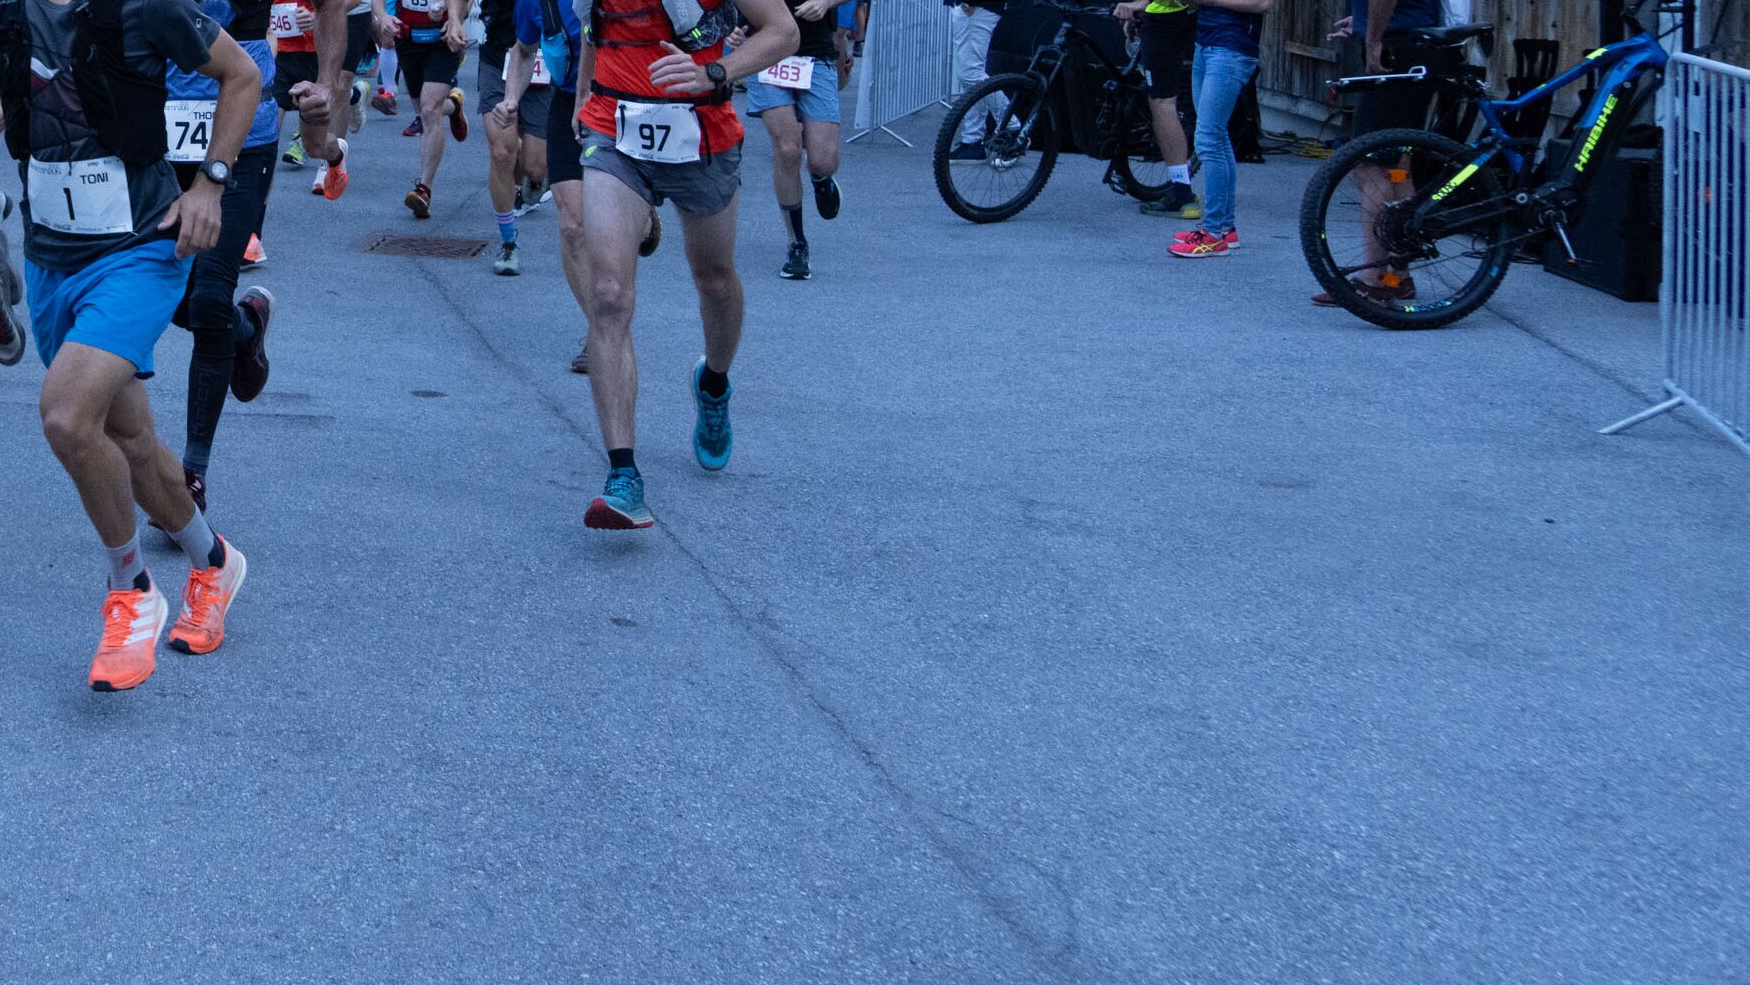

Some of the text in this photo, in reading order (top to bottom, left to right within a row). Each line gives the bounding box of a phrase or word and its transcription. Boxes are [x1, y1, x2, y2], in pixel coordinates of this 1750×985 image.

[532, 60, 542, 77] 4
[767, 63, 801, 82] 463
[193, 111, 216, 120] THO
[175, 121, 209, 150] 74
[638, 122, 672, 152] 97
[1573, 93, 1619, 173] HAIBIKE
[80, 172, 110, 185] TONI
[62, 186, 76, 222] 1
